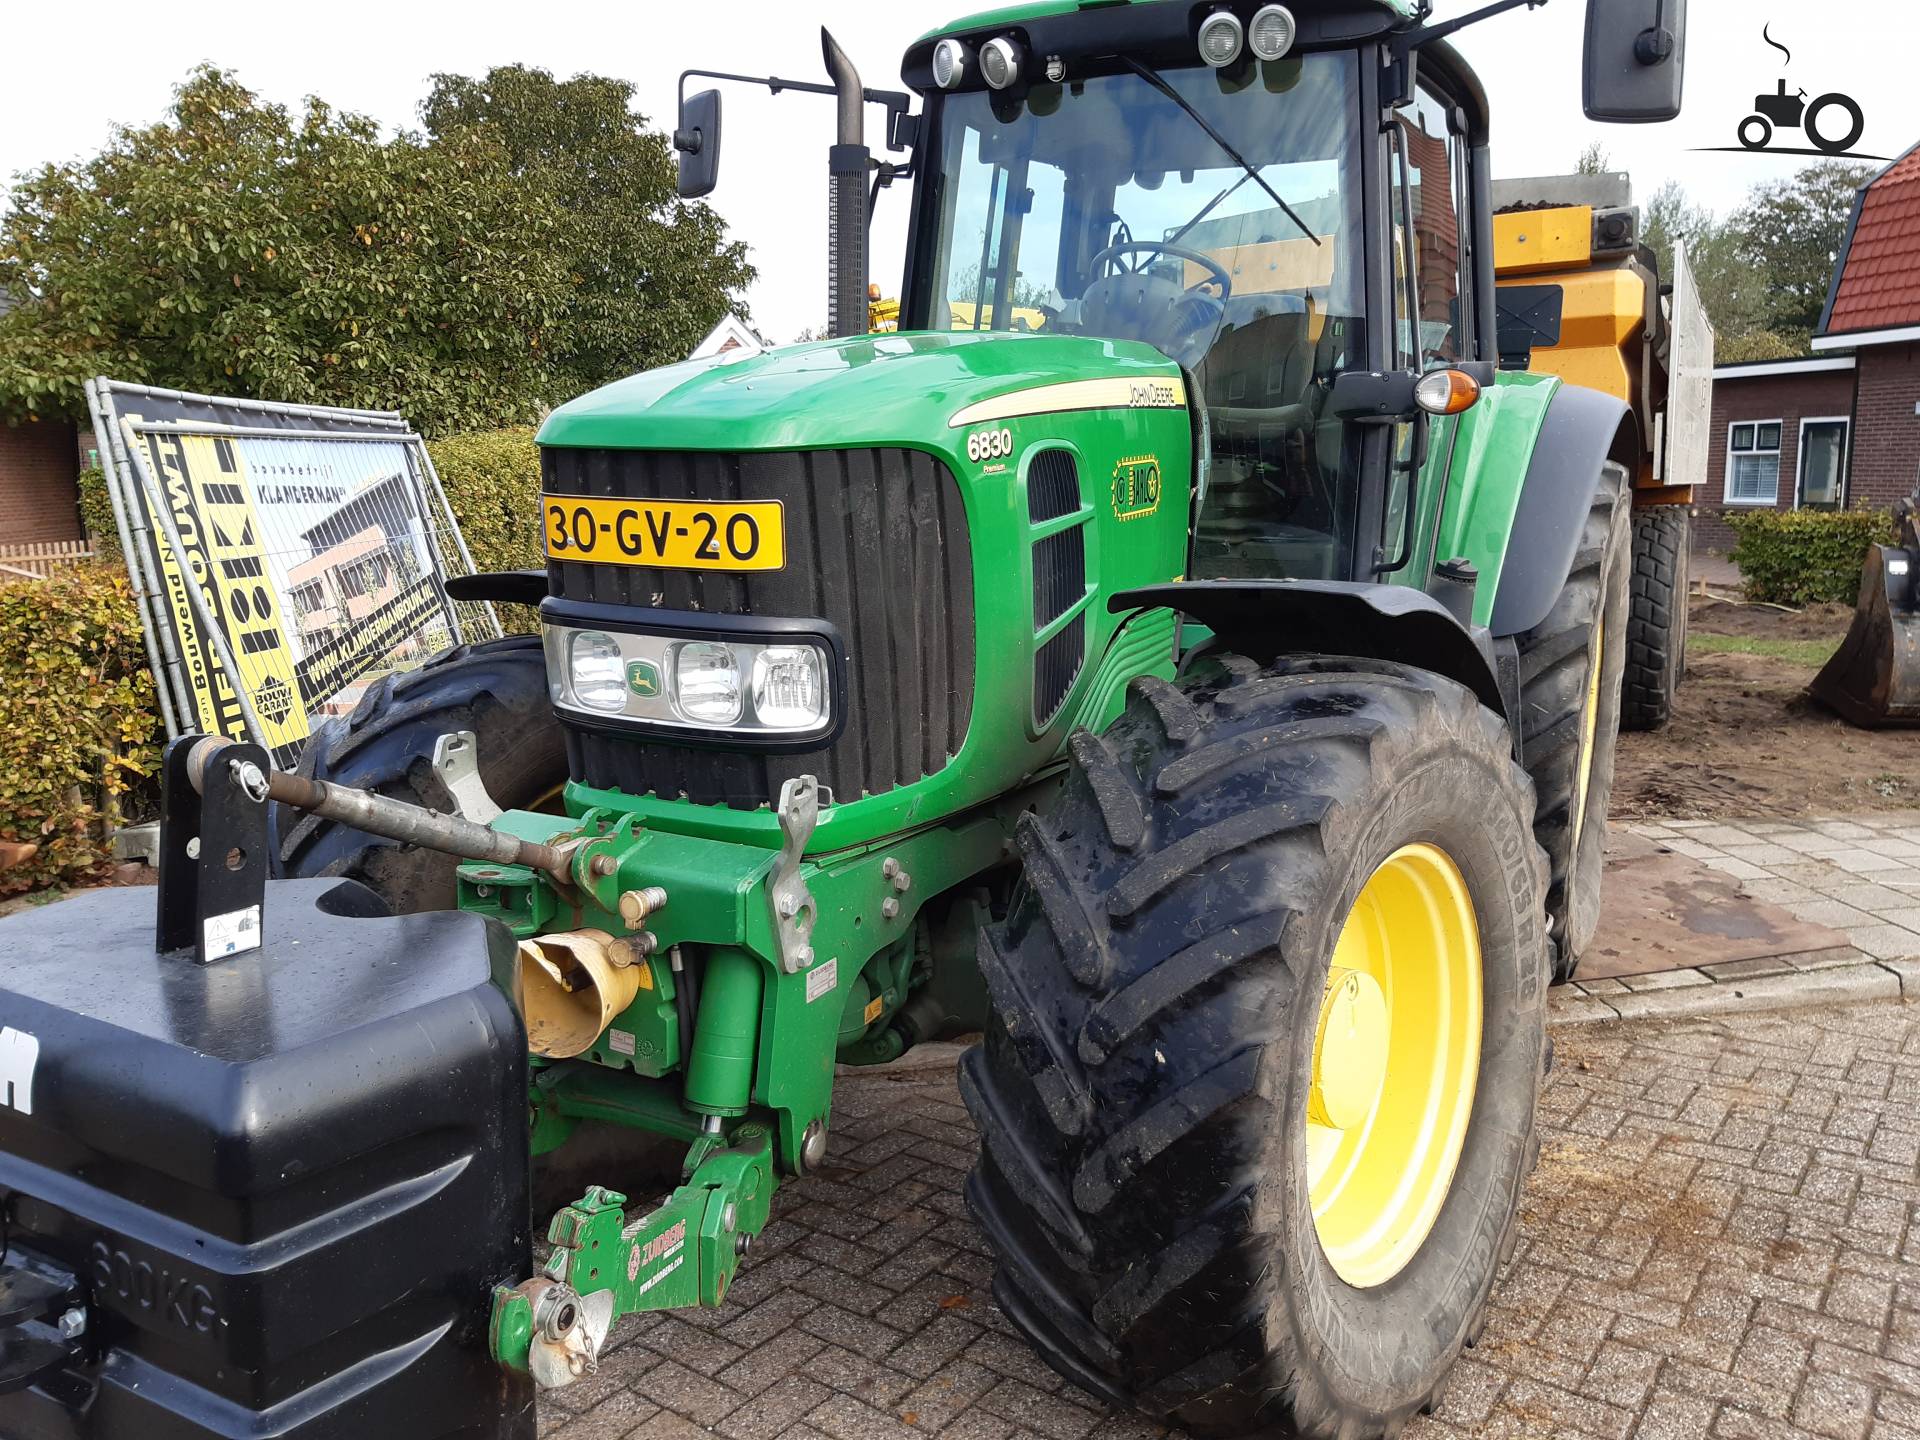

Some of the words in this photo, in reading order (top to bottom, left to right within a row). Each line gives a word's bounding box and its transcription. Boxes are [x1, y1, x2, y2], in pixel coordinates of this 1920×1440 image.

[967, 428, 1013, 463] 6830
[550, 505, 760, 561] 30-GV-20
[168, 574, 208, 690] Bouwend
[200, 697, 211, 725] van
[255, 687, 292, 705] BOUW
[641, 1218, 686, 1267] ZUIDBERG
